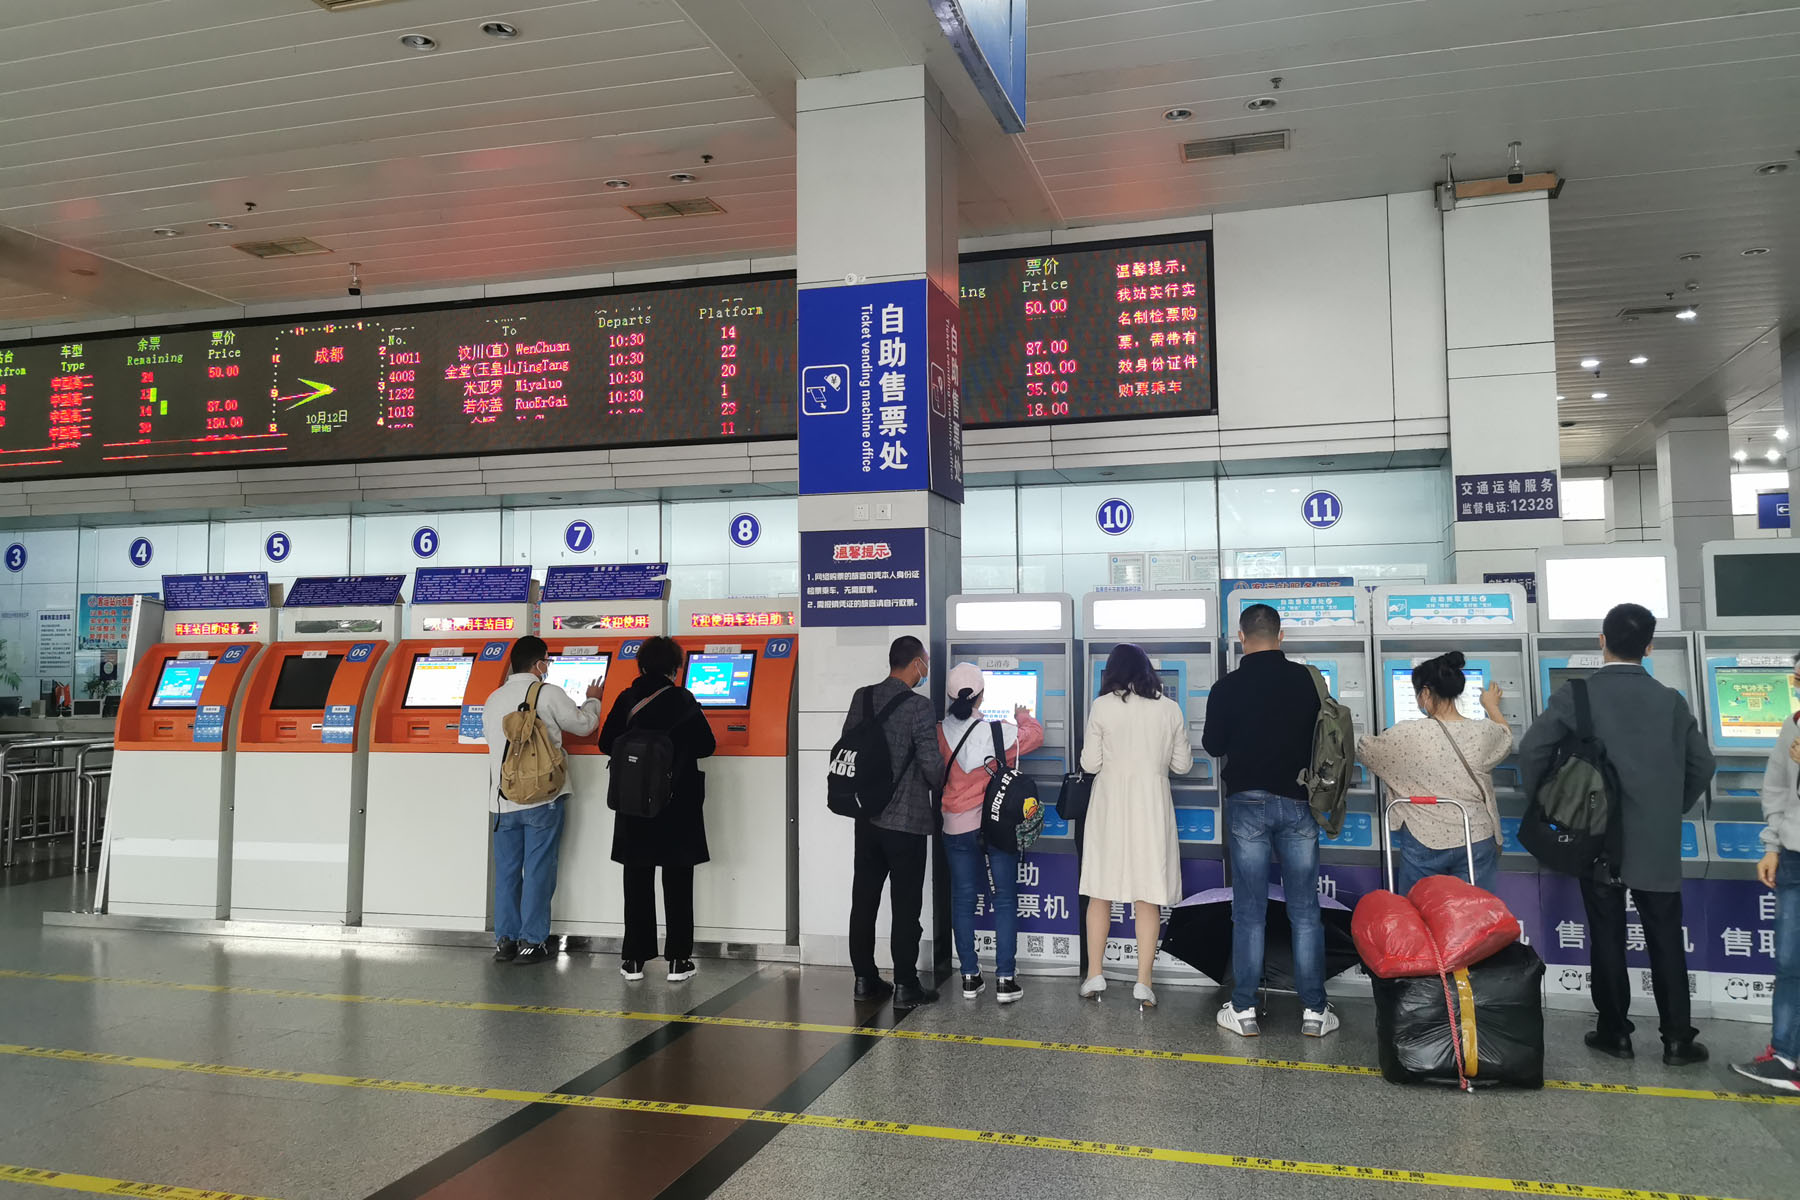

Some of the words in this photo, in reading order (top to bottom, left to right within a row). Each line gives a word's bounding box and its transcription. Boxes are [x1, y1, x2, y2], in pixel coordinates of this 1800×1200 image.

[1025, 257, 1059, 276] 票价
[960, 286, 986, 299] ing
[1022, 279, 1068, 293] Price
[1116, 282, 1197, 302] 我站实行实
[699, 305, 763, 320] Platform
[1025, 299, 1068, 315] 50.00
[598, 314, 651, 329] Departs
[861, 303, 873, 339] Ticket
[1117, 306, 1198, 326] 名制检票购
[211, 330, 236, 346] 票价
[502, 326, 517, 336] To
[721, 325, 736, 340] 14
[137, 336, 161, 352] 余票
[388, 336, 406, 346] No.
[609, 333, 645, 348] 10:30
[1026, 339, 1068, 356] 87.00
[61, 344, 83, 359] 车型
[208, 349, 241, 360] Price
[314, 346, 344, 364] 成都
[389, 352, 421, 365] 10011
[458, 342, 509, 361] 汶川(直)
[516, 340, 571, 356] WenChuan
[721, 344, 737, 358] 22
[61, 361, 85, 372] Type
[127, 353, 184, 366] Remaining
[608, 351, 644, 367] 10:30
[859, 342, 873, 387] vending
[1117, 354, 1198, 374] 效身份证件
[208, 365, 240, 379] 50.00
[515, 359, 569, 376] JingTang
[721, 364, 736, 378] 20
[1026, 359, 1077, 377] 180.00
[389, 370, 415, 383] 4008
[608, 371, 644, 385] 10:30
[388, 387, 415, 401] 1232
[464, 379, 503, 396] 米亚罗
[515, 378, 563, 393] Miyaluo
[878, 303, 908, 471] 自助售票处
[1026, 381, 1068, 396] 35.00
[1118, 380, 1182, 398] 购票乘车
[463, 397, 503, 414] 若尔盖
[515, 395, 569, 411] RuoErGai
[607, 389, 644, 404] 10:30
[206, 400, 239, 413] 87.00
[387, 405, 415, 419] 1018
[861, 389, 873, 438] machine
[1026, 402, 1069, 417] 18.00
[206, 417, 244, 430] 180.00
[305, 410, 348, 424] 10月12日
[721, 421, 736, 435] 11
[861, 439, 874, 472] office
[1461, 478, 1554, 496] 交通运输服务
[1102, 504, 1128, 528] 10
[1309, 497, 1336, 522] 11
[573, 526, 587, 547] 7
[738, 519, 753, 541] 8
[271, 538, 285, 556] 5
[419, 535, 433, 551] 6
[12, 548, 22, 567] 3
[135, 543, 147, 562] 4
[834, 544, 891, 560] 温馨提示
[600, 615, 650, 629] 欢迎使用
[225, 650, 240, 658] 05
[351, 648, 367, 657] 06
[485, 647, 501, 656] 08
[623, 644, 640, 654] 09
[770, 643, 787, 652] 10
[836, 749, 857, 763] I'M
[830, 759, 856, 778] ADC
[991, 790, 1005, 822] B.DUCK
[1001, 773, 1013, 785] BE
[1016, 862, 1040, 887] 助
[1318, 874, 1337, 900] 助
[1758, 892, 1776, 921] 自
[1246, 1057, 1382, 1073] 请保持一米线距
[1511, 1180, 1722, 1200] 请保持一米线距
